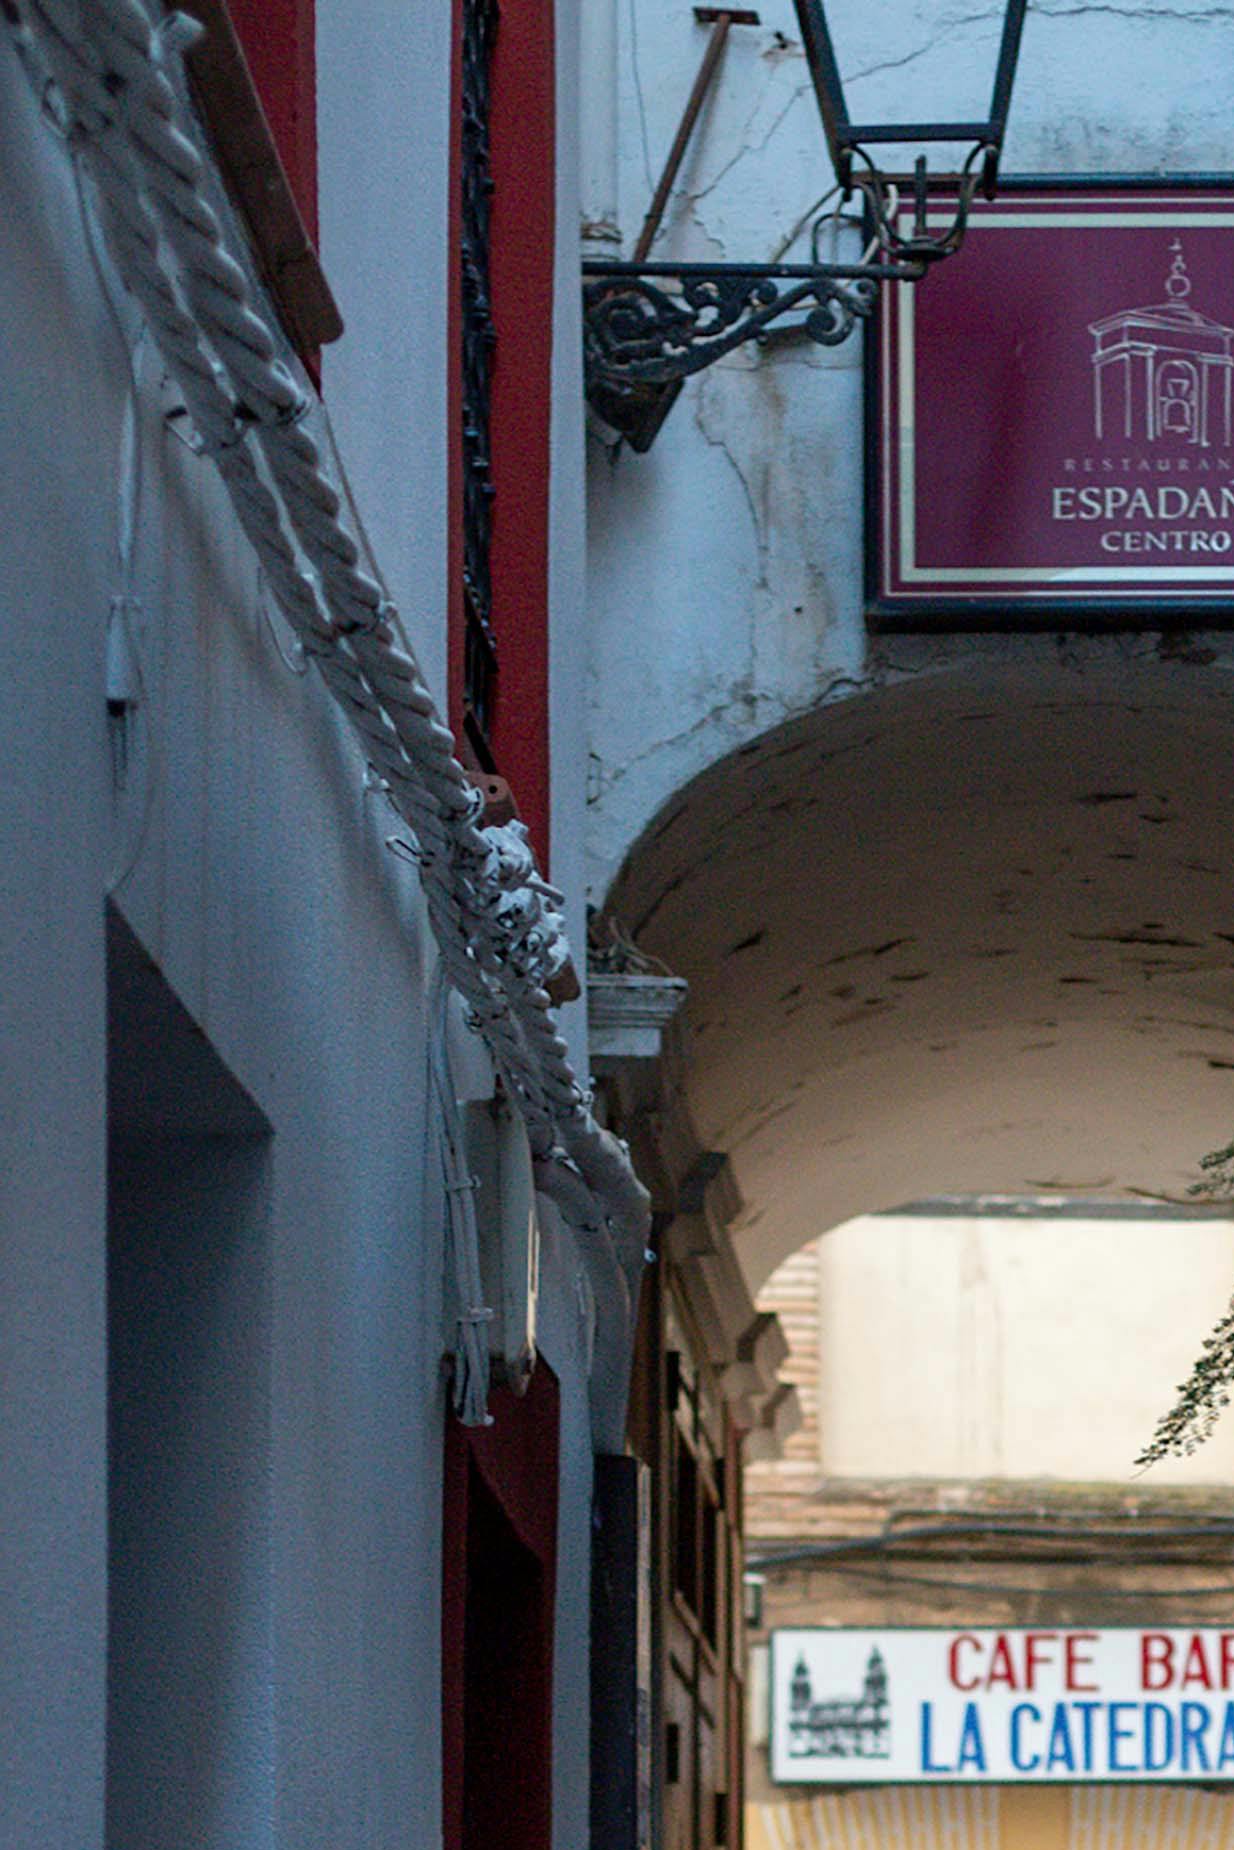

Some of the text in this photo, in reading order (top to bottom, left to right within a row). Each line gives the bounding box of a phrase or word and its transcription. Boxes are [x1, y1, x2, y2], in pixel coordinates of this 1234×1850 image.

[1101, 530, 1232, 552] CENTRO
[948, 1632, 1100, 1692] CAFE
[920, 1701, 987, 1773] LA
